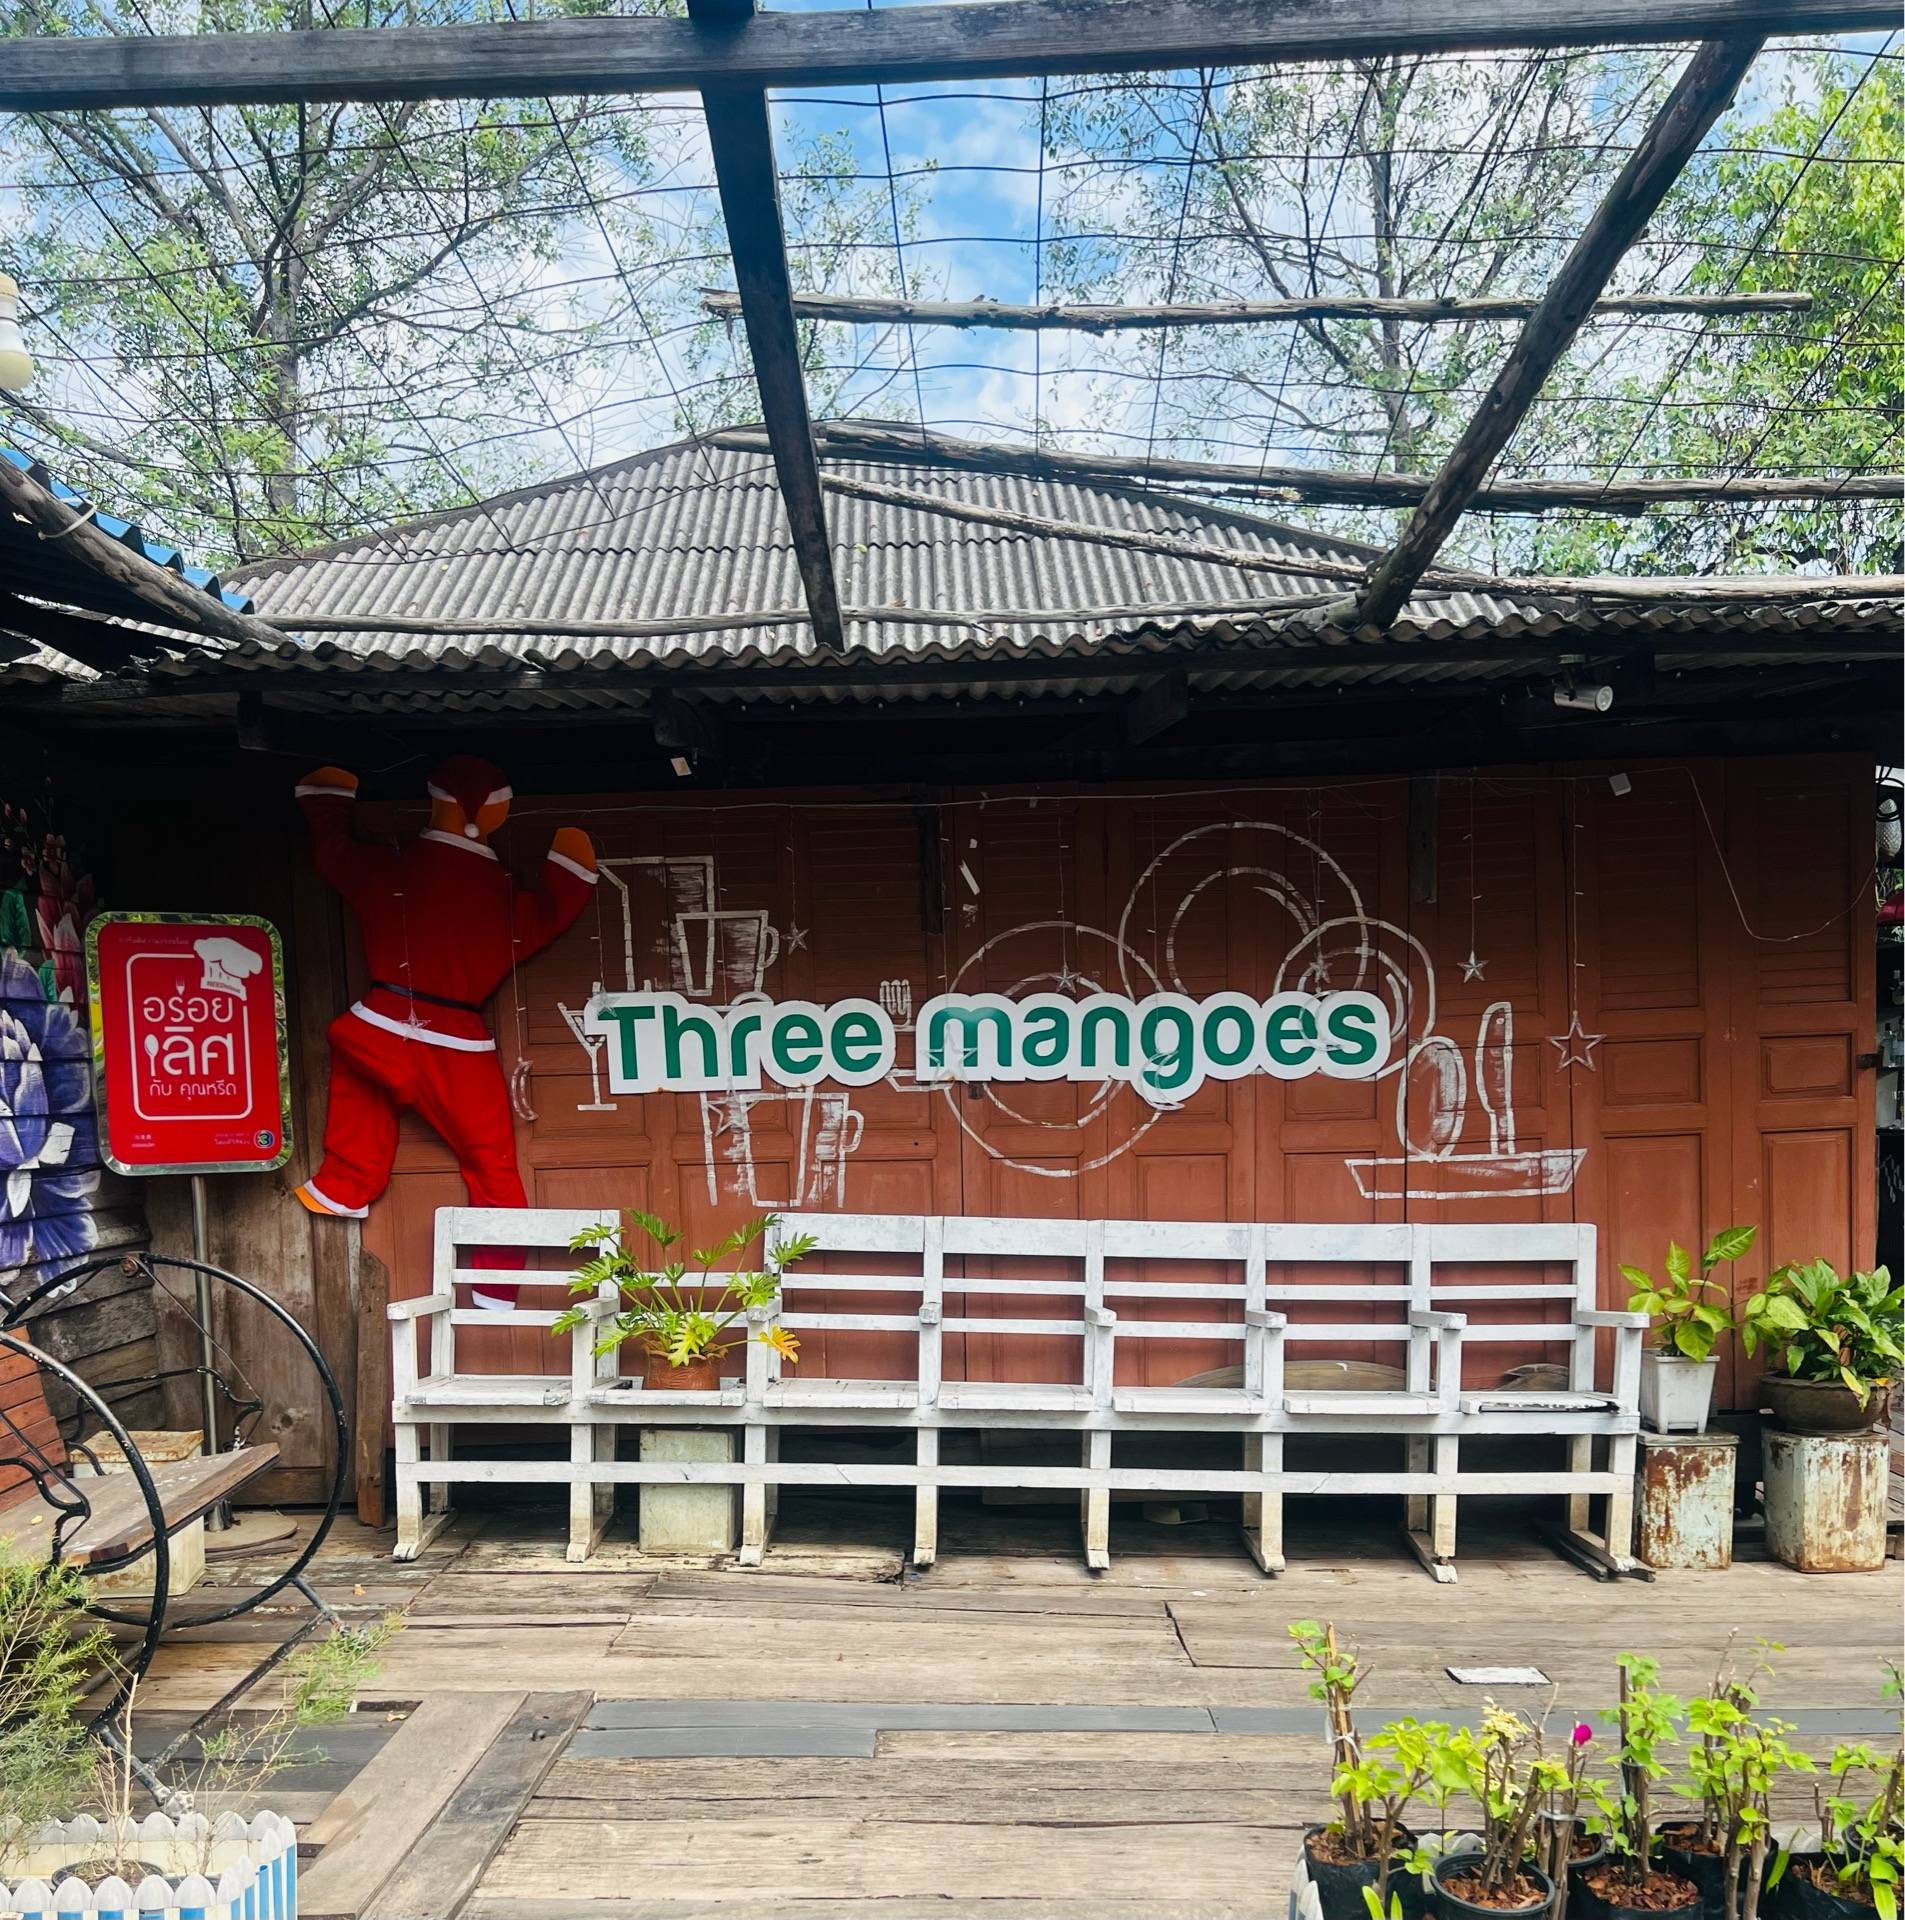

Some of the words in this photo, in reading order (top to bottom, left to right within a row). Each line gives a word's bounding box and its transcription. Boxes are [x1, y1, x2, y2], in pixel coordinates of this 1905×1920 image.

[598, 1006, 882, 1080] Three
[928, 1005, 1377, 1090] mangoes
[149, 1079, 172, 1096] กับ
